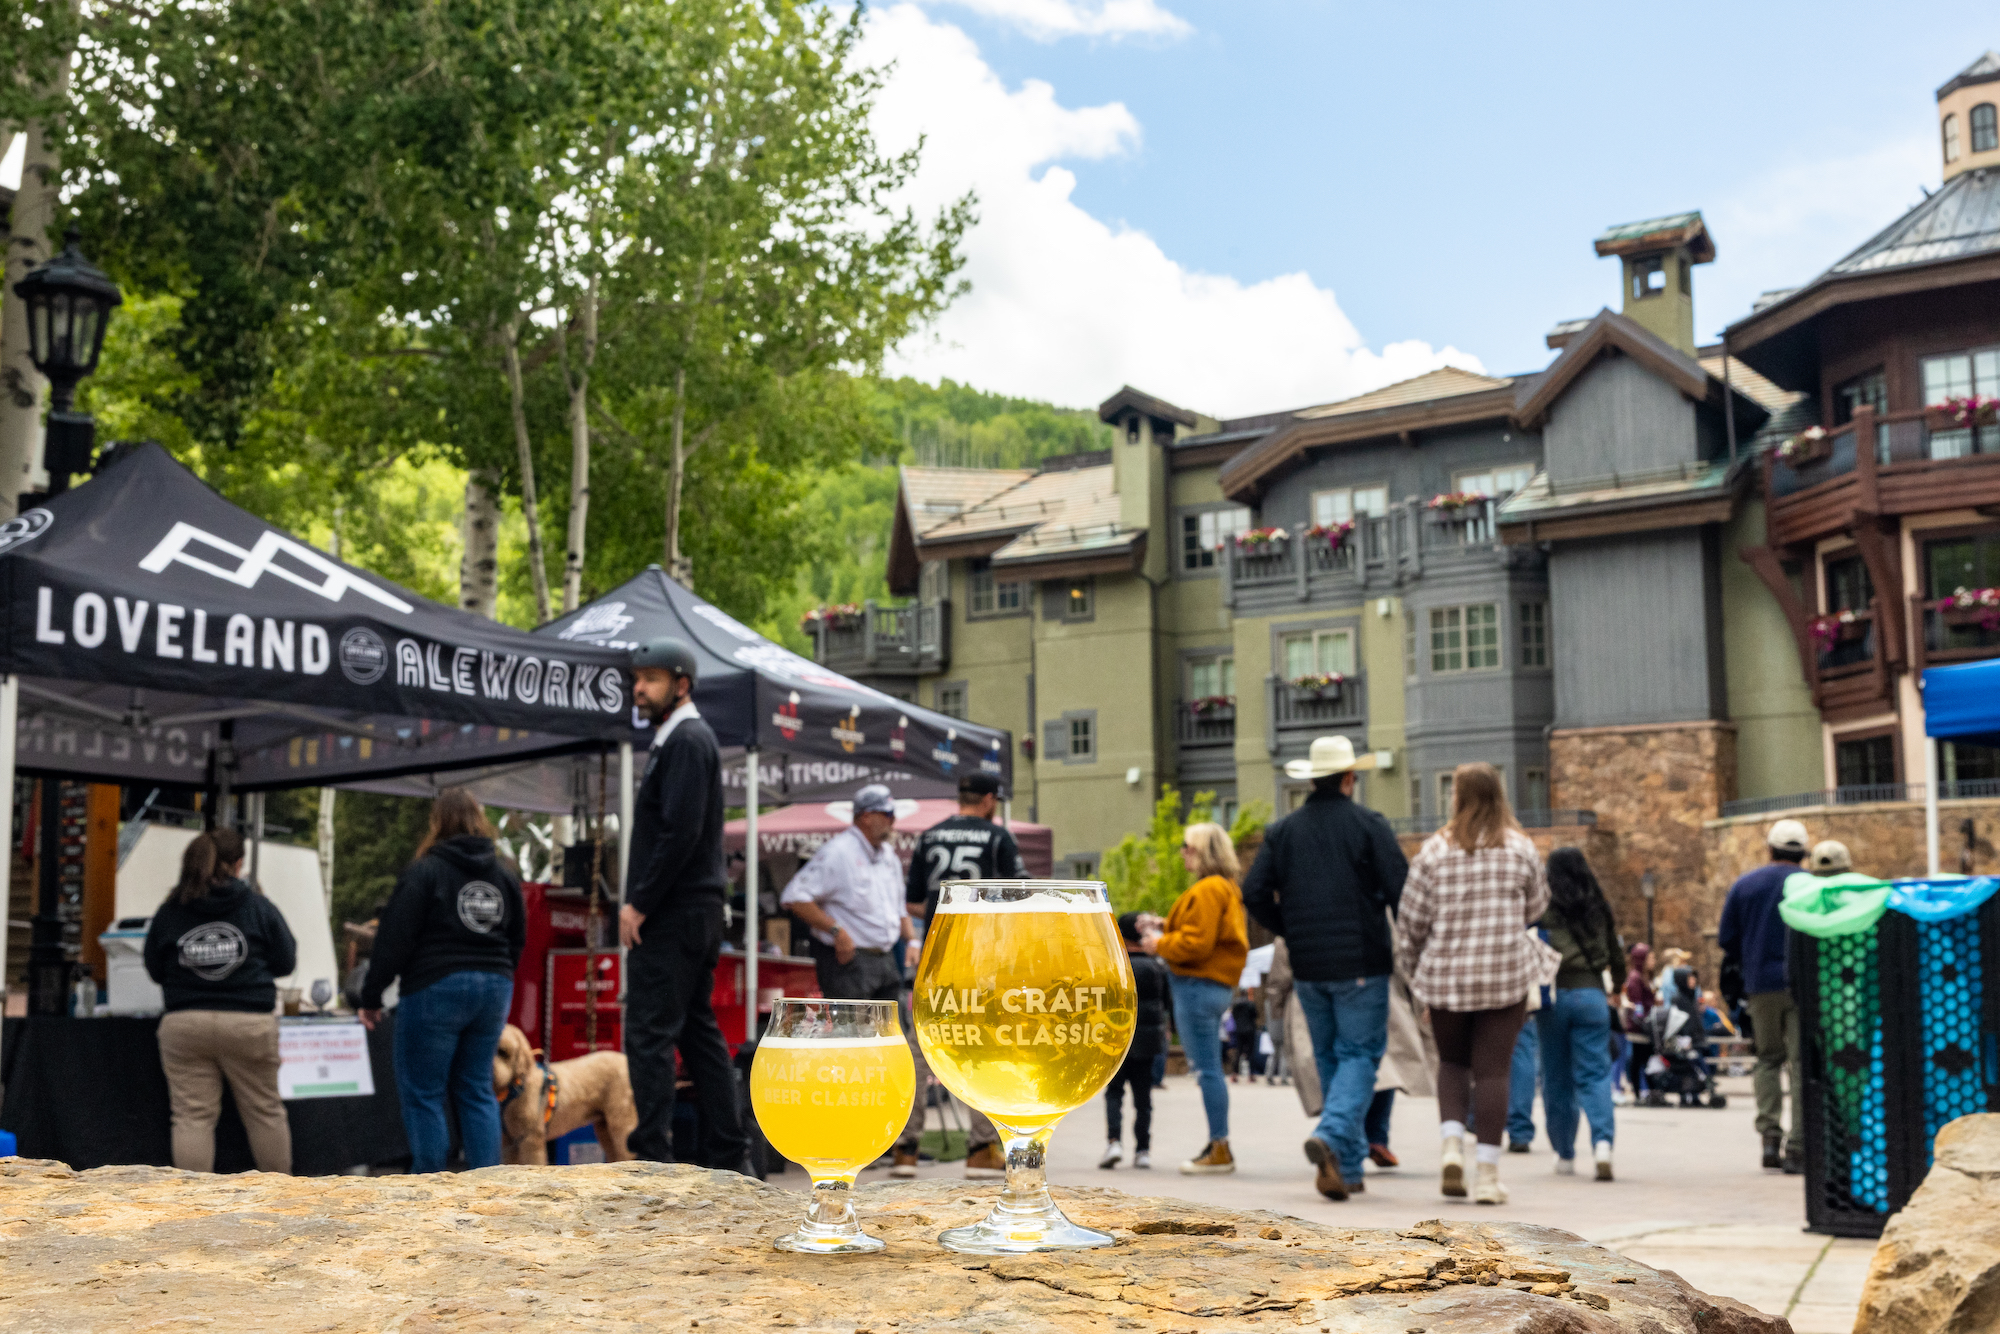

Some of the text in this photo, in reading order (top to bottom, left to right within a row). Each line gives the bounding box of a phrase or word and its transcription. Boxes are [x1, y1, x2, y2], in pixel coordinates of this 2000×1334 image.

[36, 585, 624, 714] LOVELAND ALEWORKS
[926, 845, 984, 891] 25
[928, 986, 1106, 1014] VAIL CRAFT
[929, 1022, 1106, 1046] BEER CLASSIC
[766, 1063, 887, 1083] VAIL CRAFT
[765, 1088, 887, 1107] BEER CLASSIC
